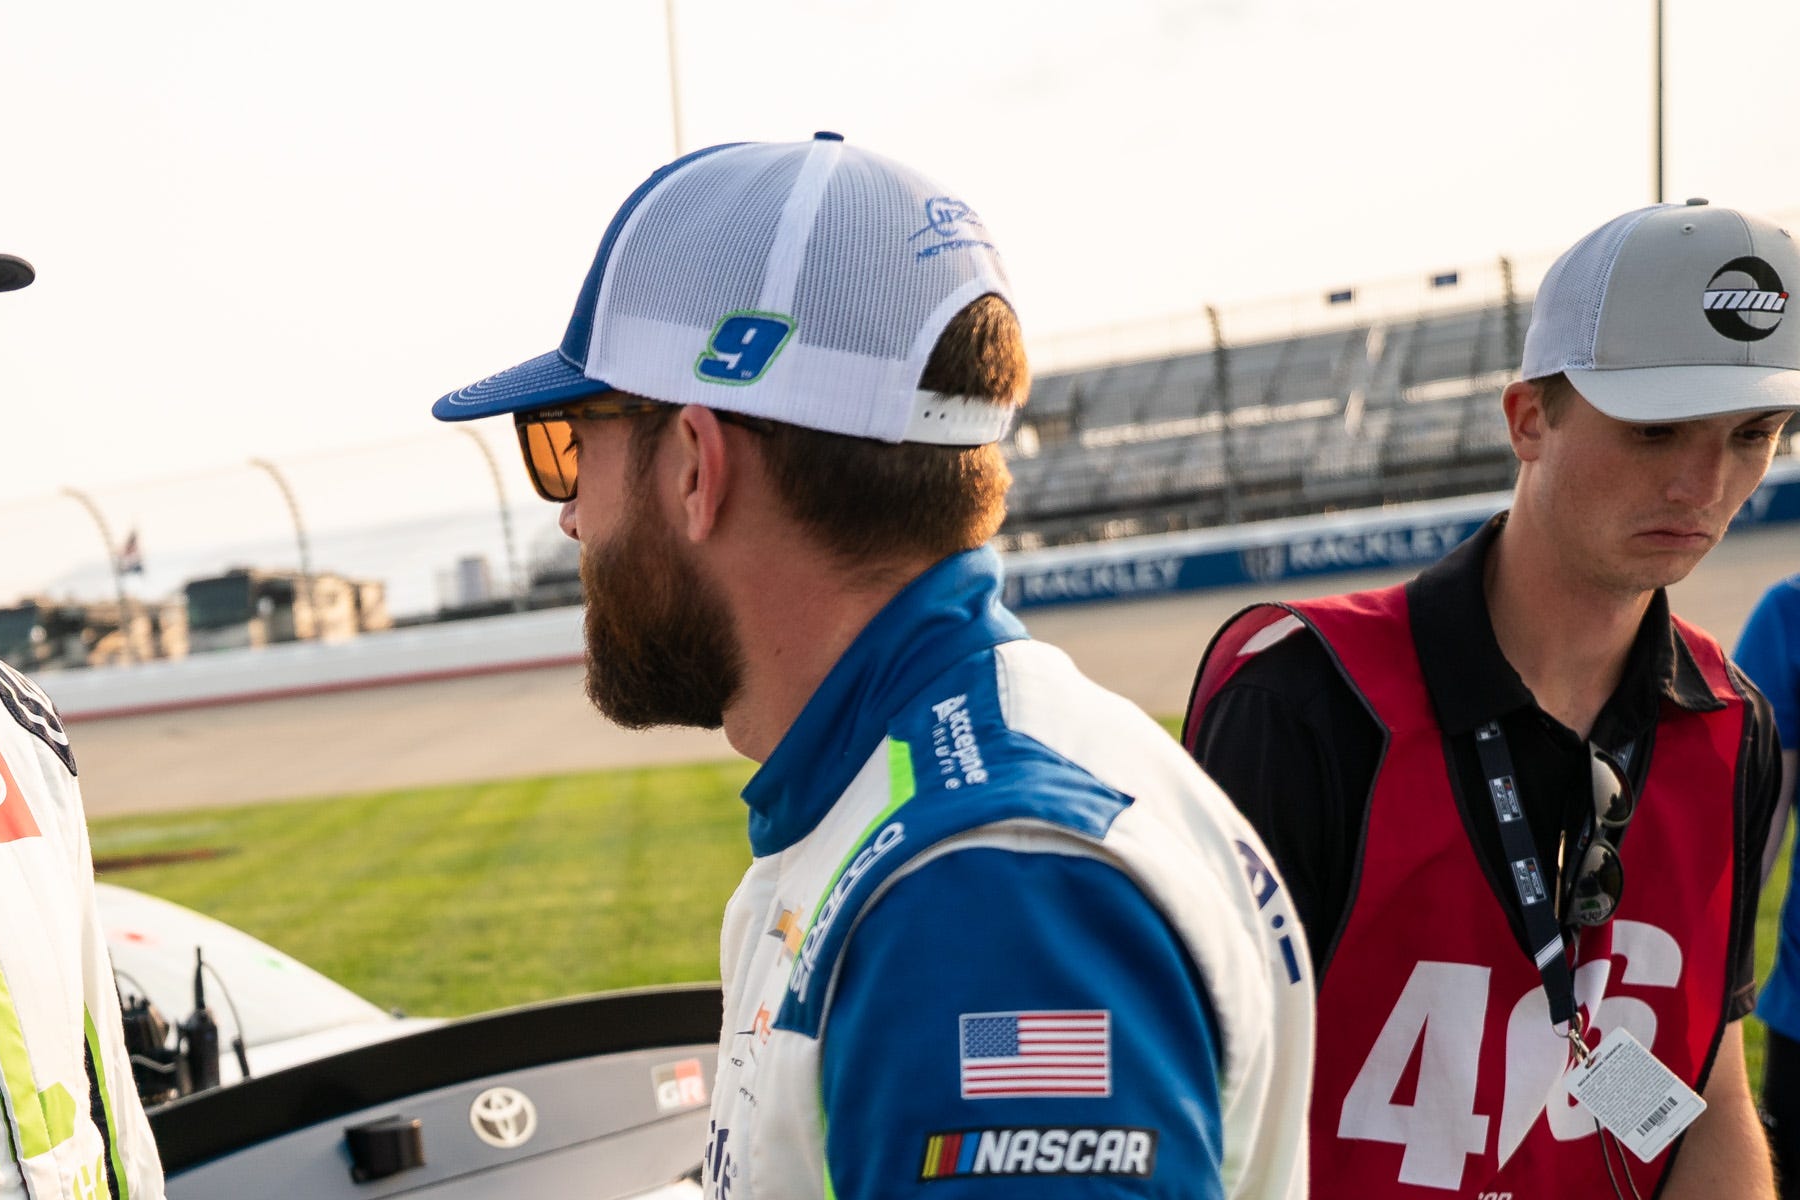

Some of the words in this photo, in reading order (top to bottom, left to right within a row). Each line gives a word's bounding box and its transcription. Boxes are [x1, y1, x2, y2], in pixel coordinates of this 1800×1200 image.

[697, 314, 792, 382] 9
[789, 821, 906, 1003] sparco
[972, 1129, 1152, 1175] NASCAR
